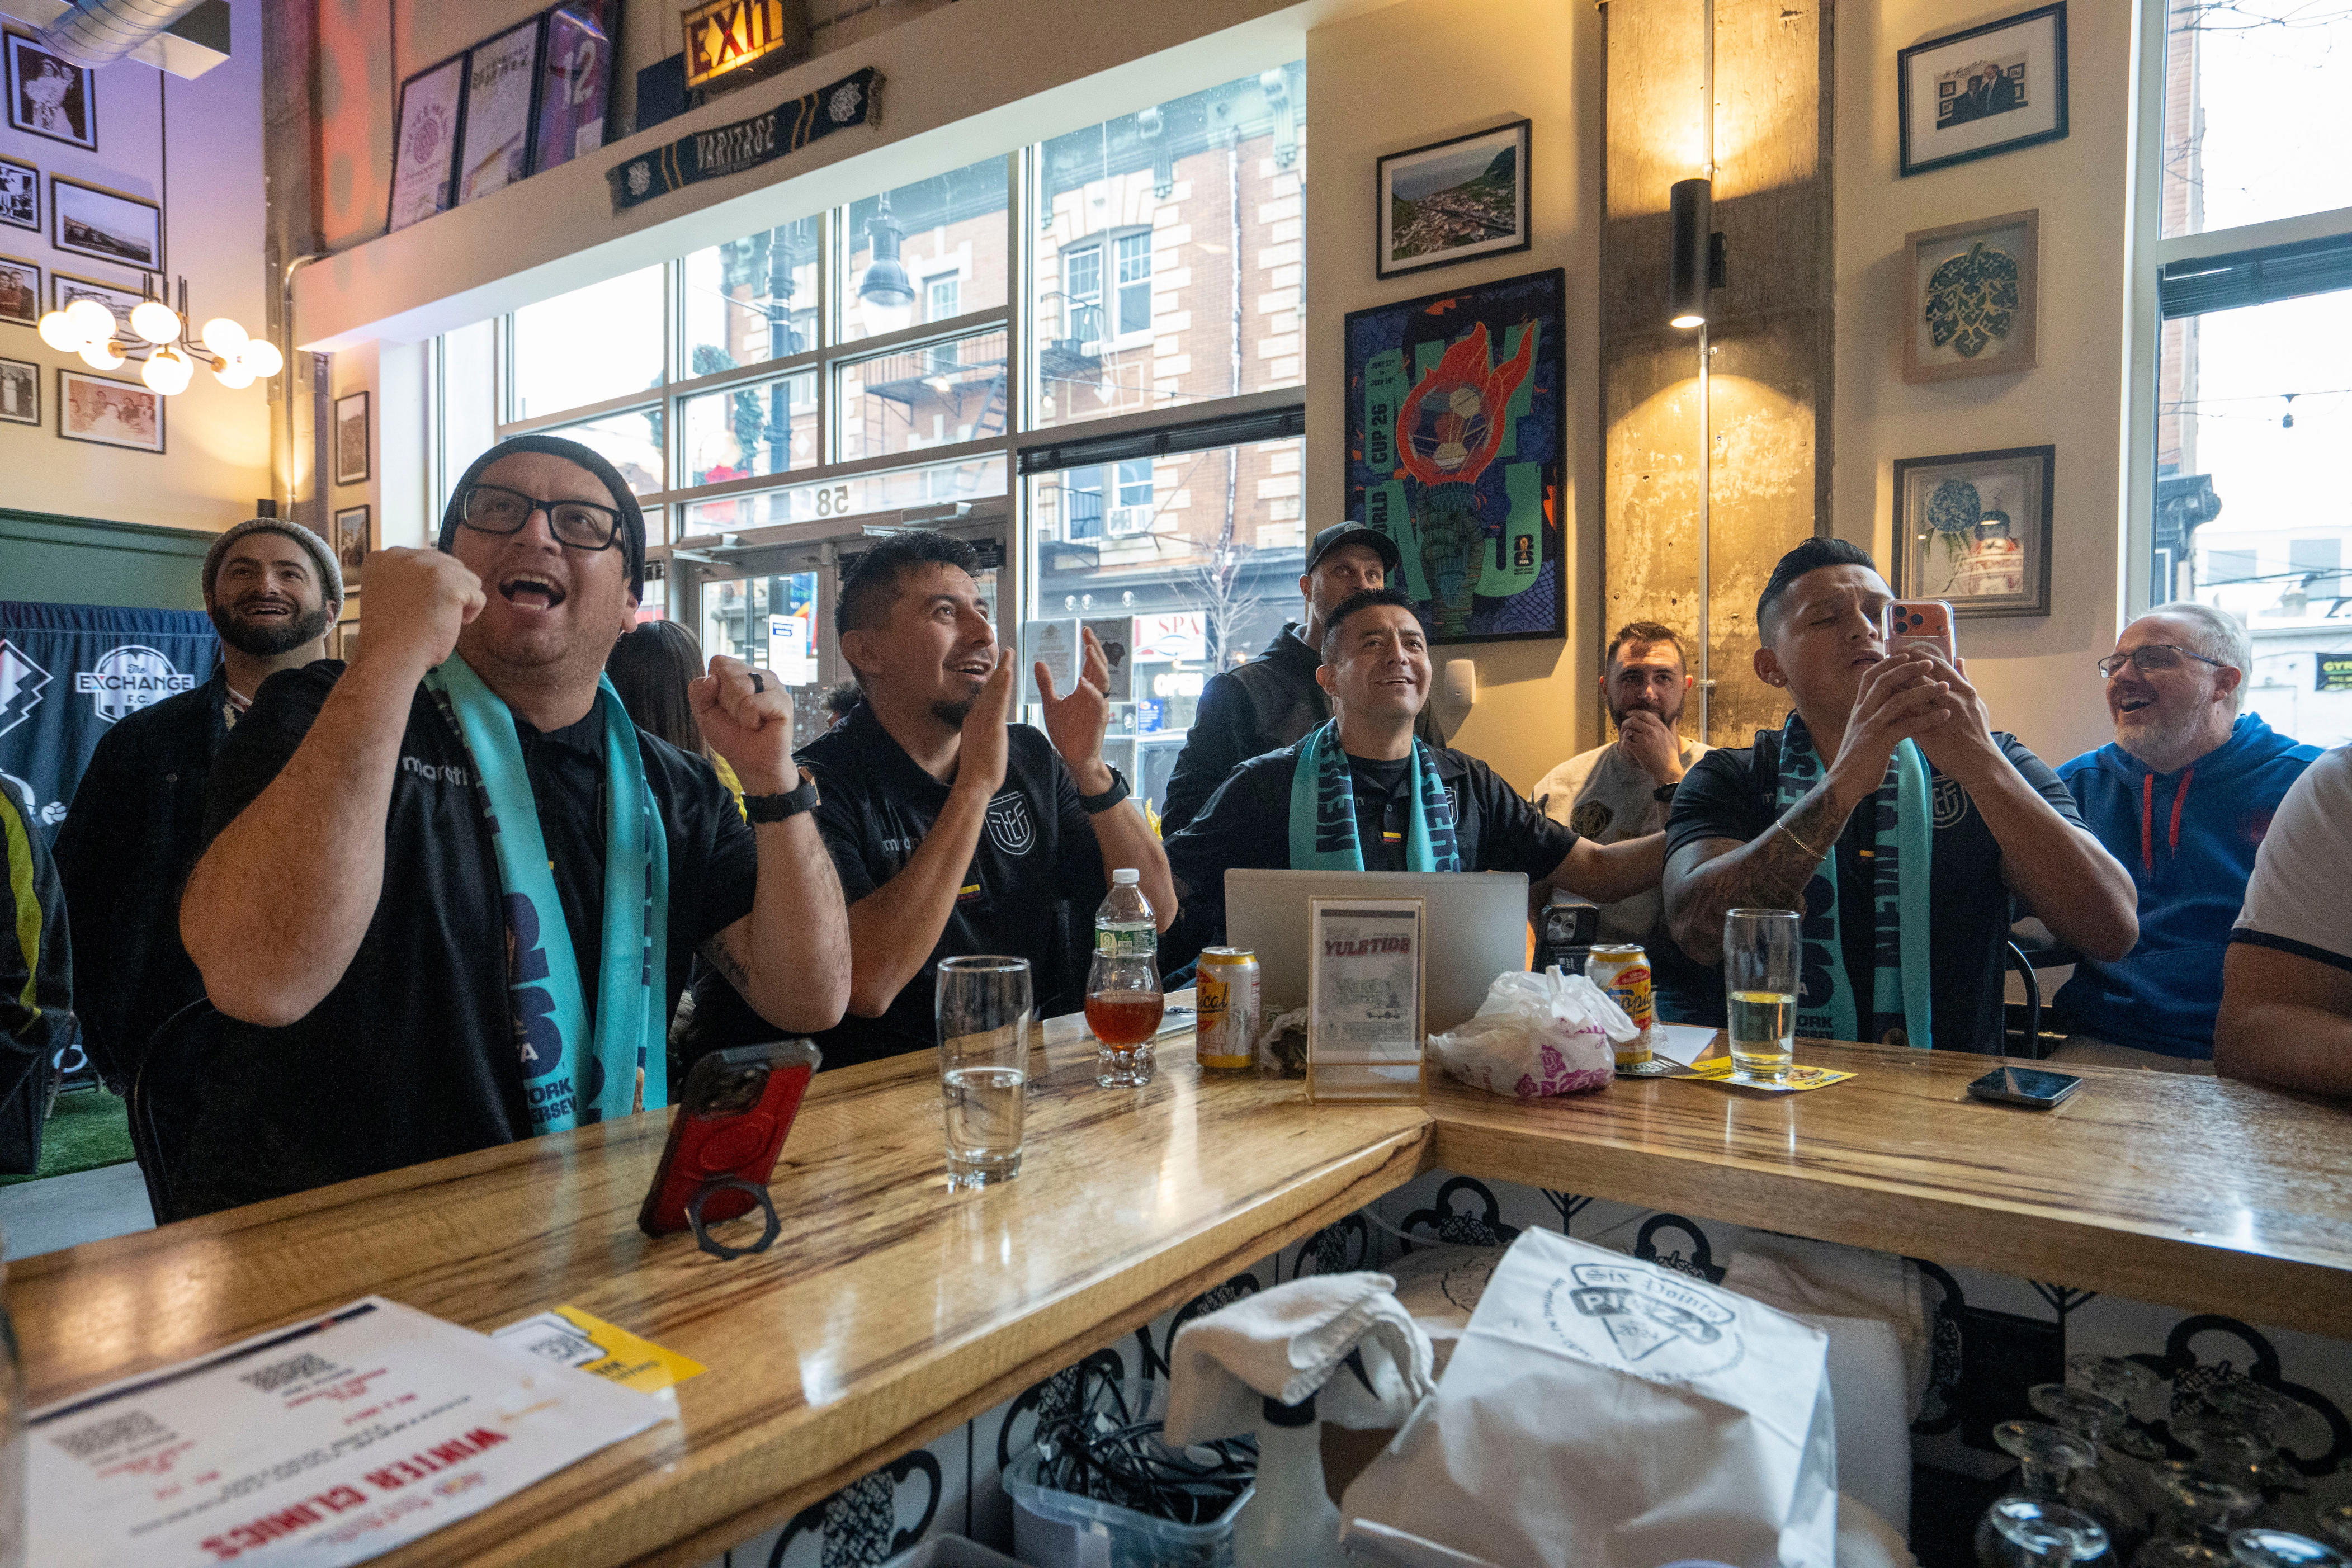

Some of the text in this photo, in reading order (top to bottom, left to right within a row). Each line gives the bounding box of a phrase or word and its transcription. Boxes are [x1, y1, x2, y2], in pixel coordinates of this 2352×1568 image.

[691, 0, 772, 76] EXIT
[697, 114, 777, 169] VARITAGE
[1371, 403, 1388, 532] ORLD CUP 26
[1159, 616, 1200, 636] SPA
[127, 664, 147, 674] The
[80, 675, 191, 691] EXCHANGE
[127, 695, 150, 704] F.C.
[1324, 937, 1411, 957] YULETIDE
[1796, 1014, 1834, 1028] ORK
[528, 1077, 573, 1104] ORK
[1586, 1269, 1631, 1284] Six
[1582, 1292, 1704, 1341] PIZZA
[364, 1427, 508, 1491] WINTER
[200, 1485, 367, 1560] CLINICS
